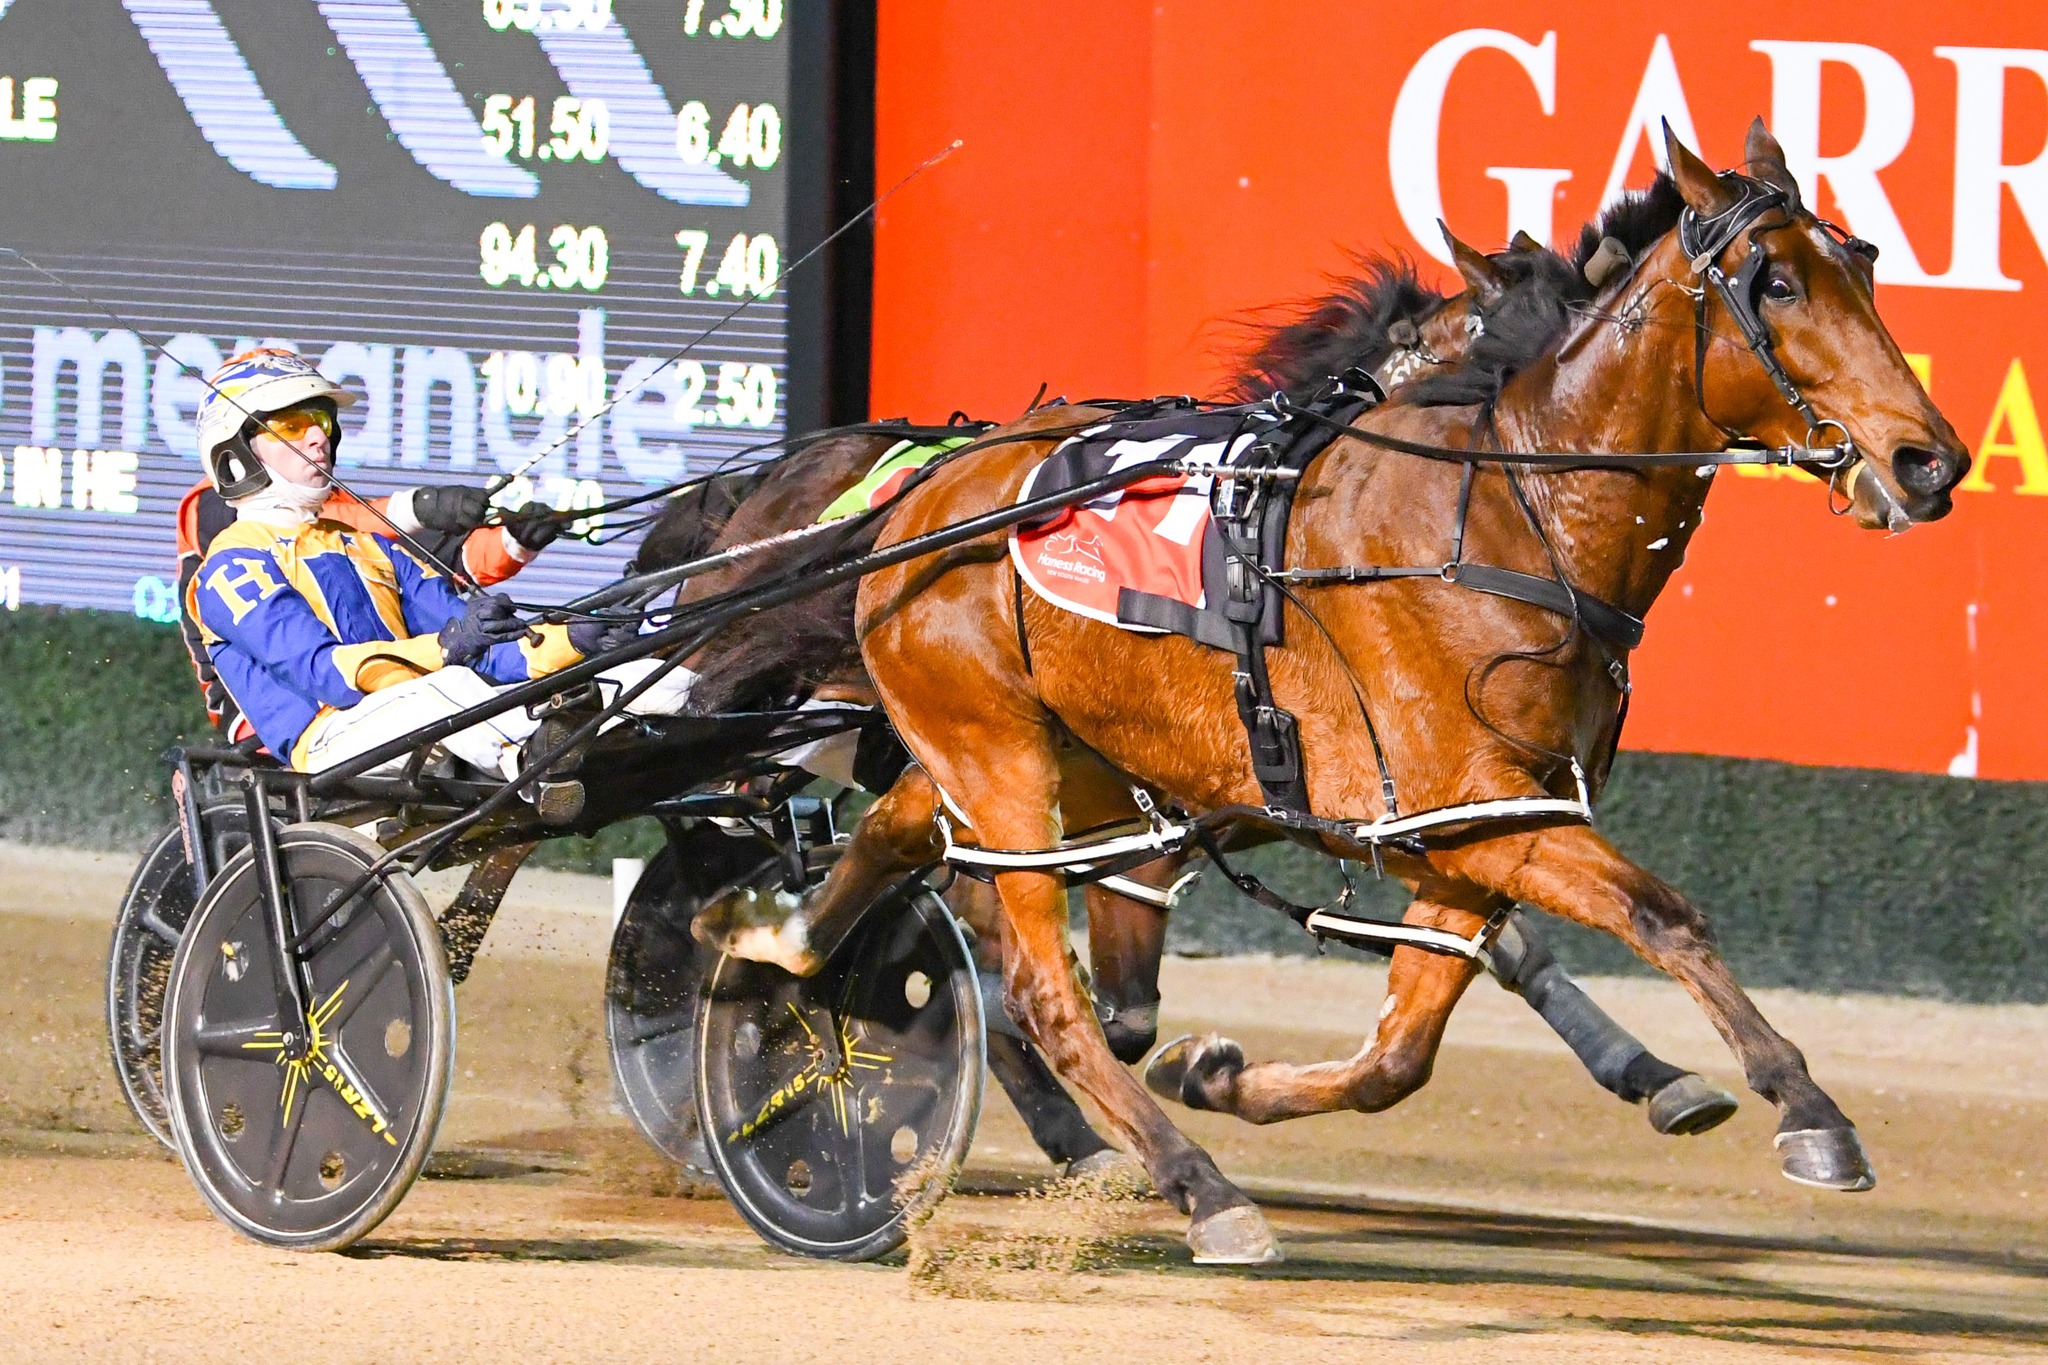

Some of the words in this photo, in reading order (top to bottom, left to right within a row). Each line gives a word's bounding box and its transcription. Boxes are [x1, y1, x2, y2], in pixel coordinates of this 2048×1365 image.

[482, 94, 611, 163] 51.50
[676, 101, 782, 169] 6.40
[480, 222, 609, 291] 94.30
[675, 230, 781, 299] 7.40
[673, 361, 777, 427] 2.50
[72, 449, 139, 513] HE
[205, 558, 287, 626] H
[1073, 561, 1106, 583] Racing
